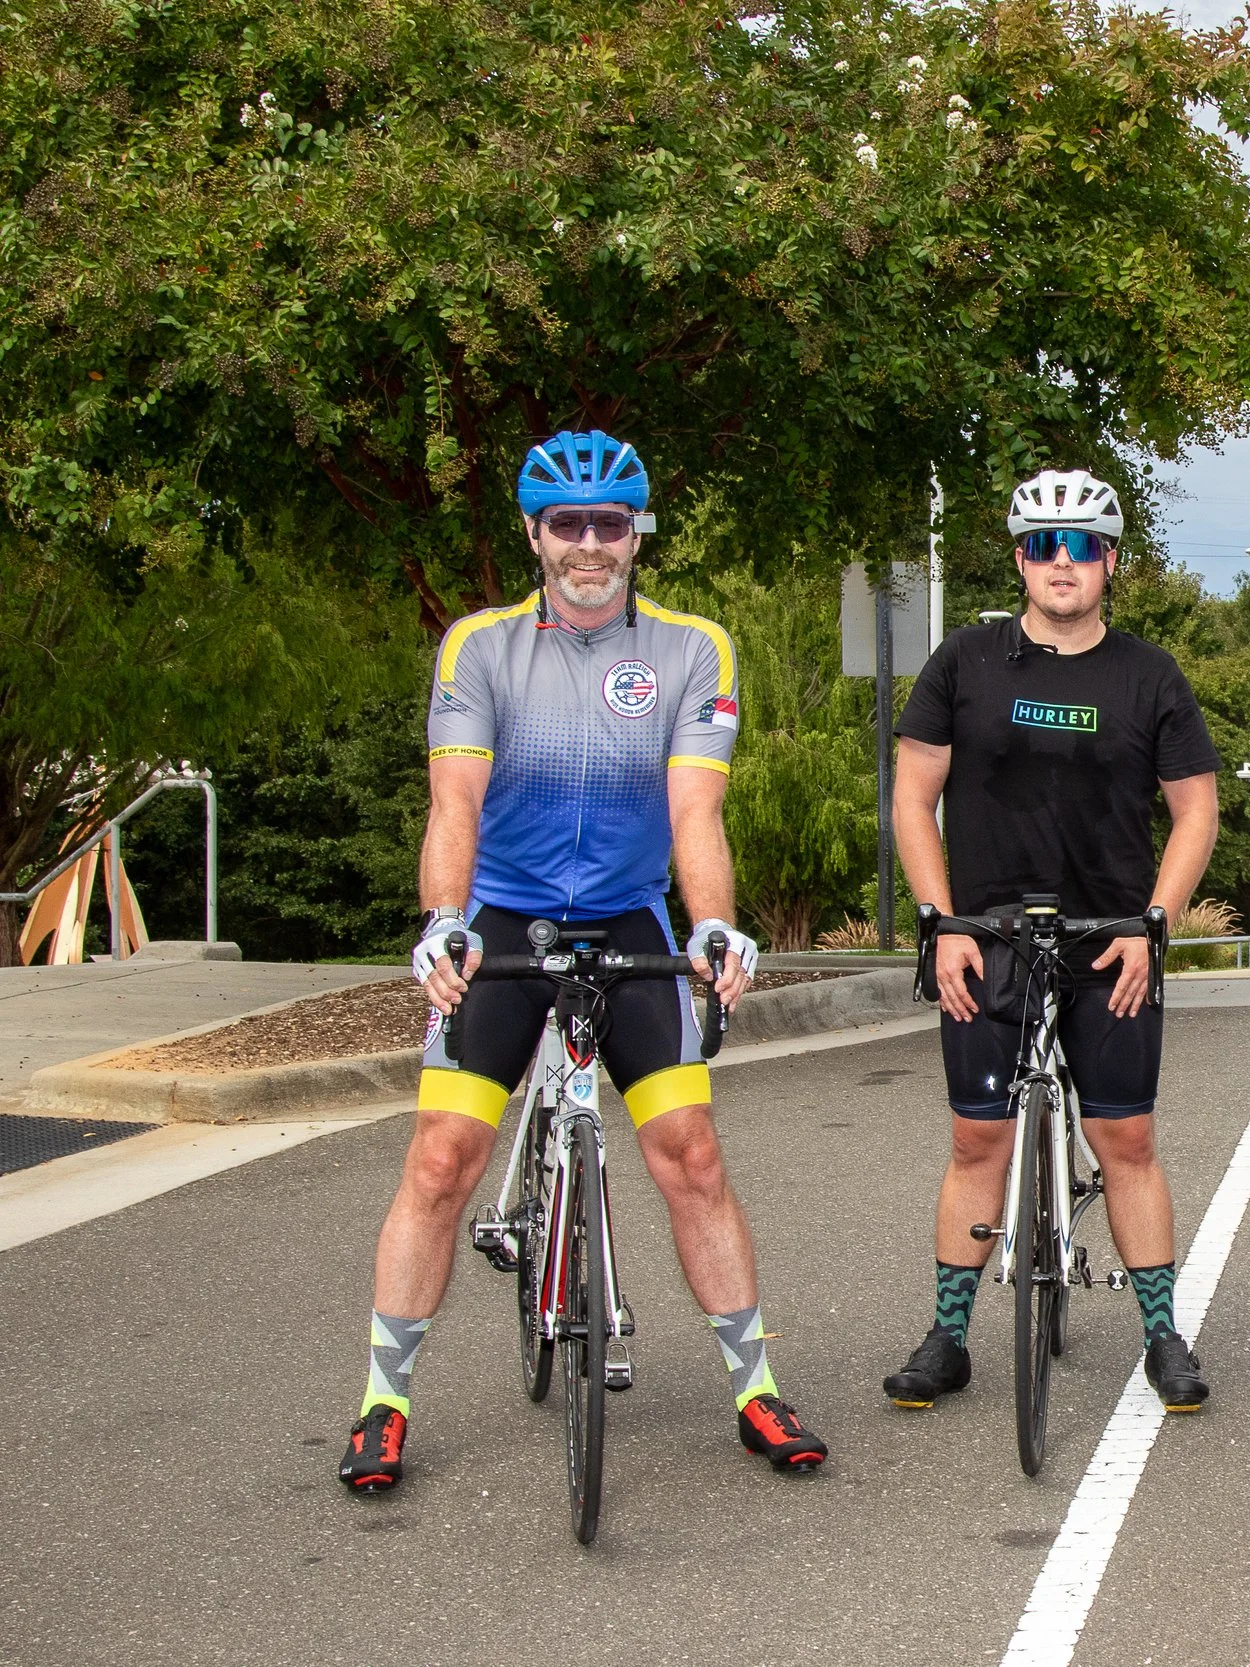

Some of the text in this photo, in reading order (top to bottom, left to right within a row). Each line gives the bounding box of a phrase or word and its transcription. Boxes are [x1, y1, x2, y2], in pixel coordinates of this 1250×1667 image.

[611, 663, 627, 676] TEAM
[1018, 705, 1092, 726] HURLEY
[460, 748, 488, 757] HONOR
